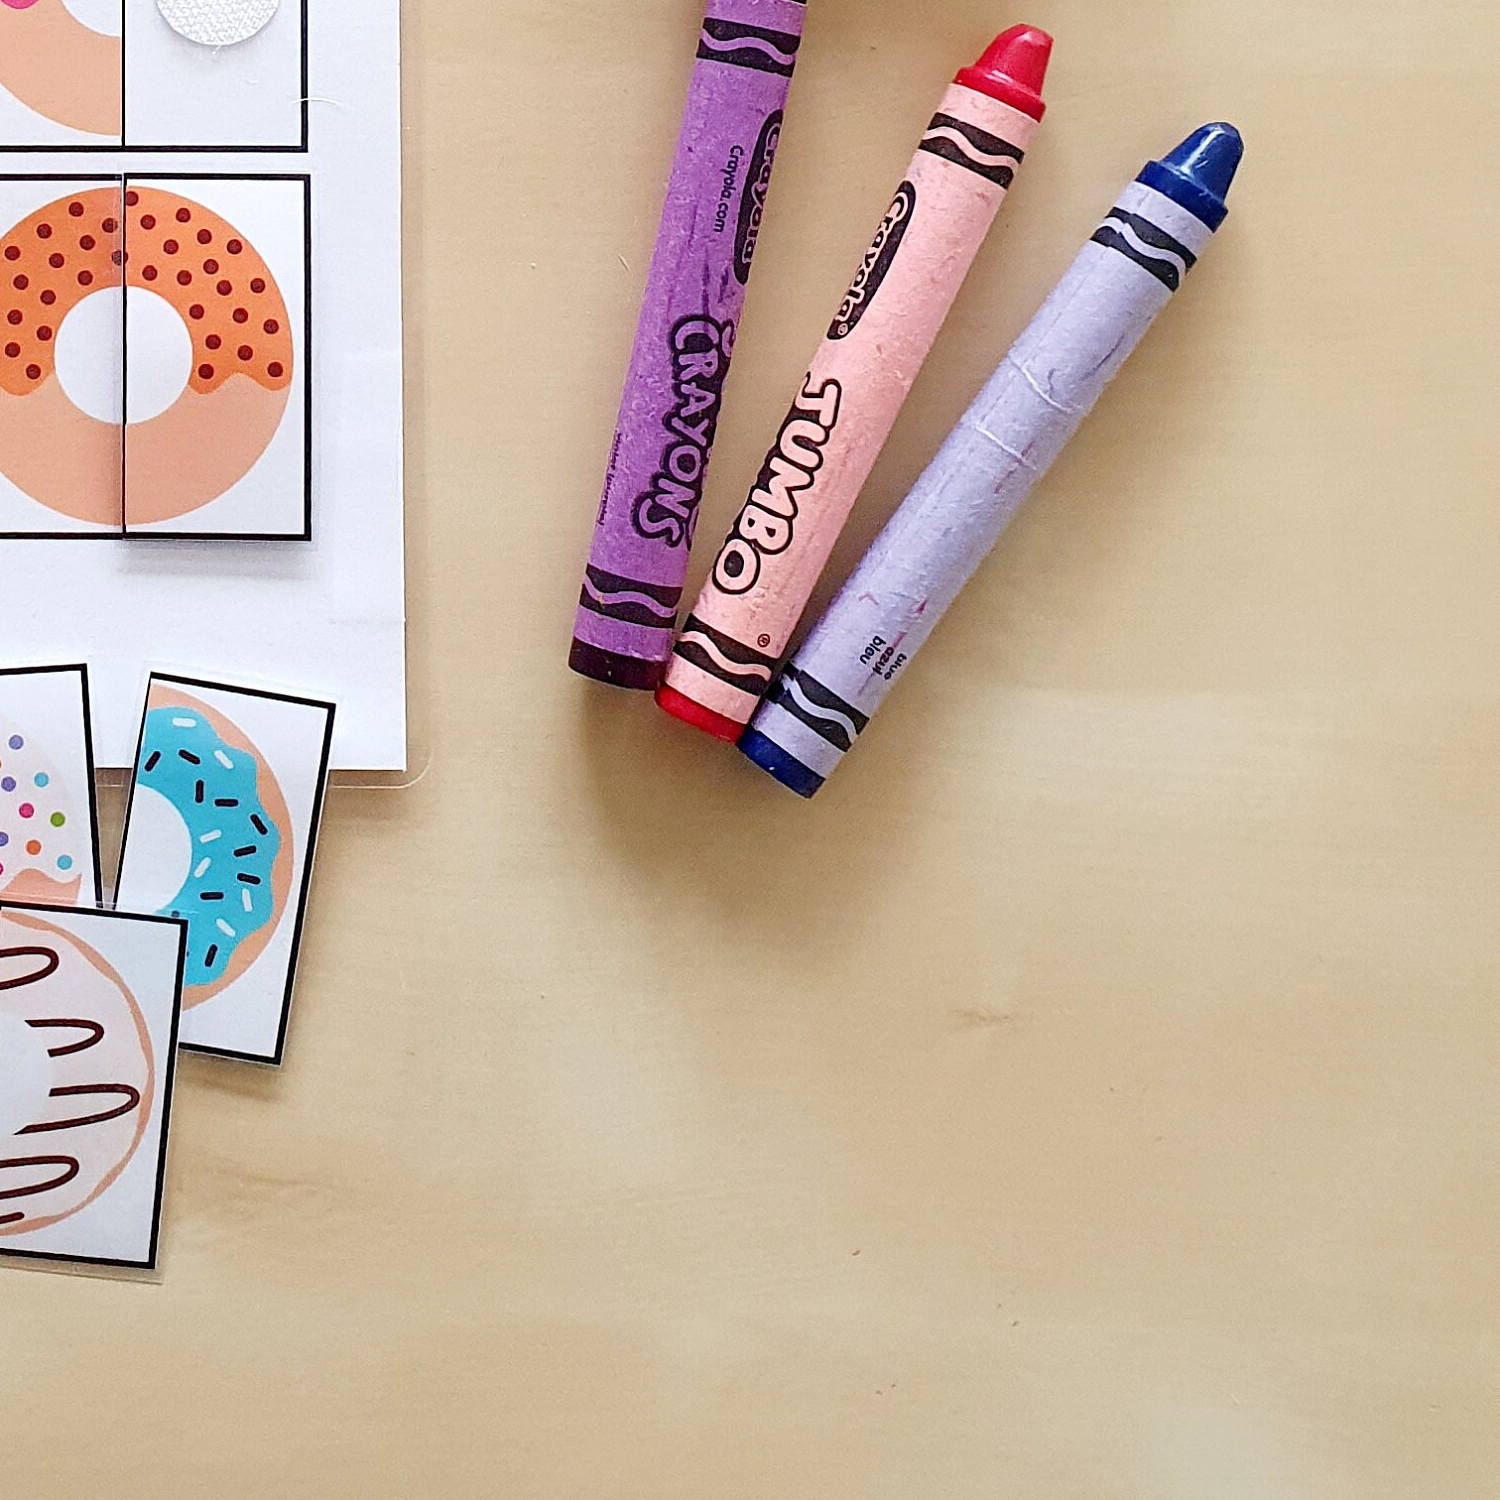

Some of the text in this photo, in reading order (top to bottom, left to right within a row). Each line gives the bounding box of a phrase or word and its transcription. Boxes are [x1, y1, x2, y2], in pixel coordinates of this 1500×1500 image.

[713, 144, 744, 234] Crayola.com
[833, 191, 909, 322] Crayola
[630, 314, 723, 547] CRAYONS
[711, 372, 842, 595] JUMBO
[859, 635, 887, 665] bleu
[883, 652, 908, 680] blue
